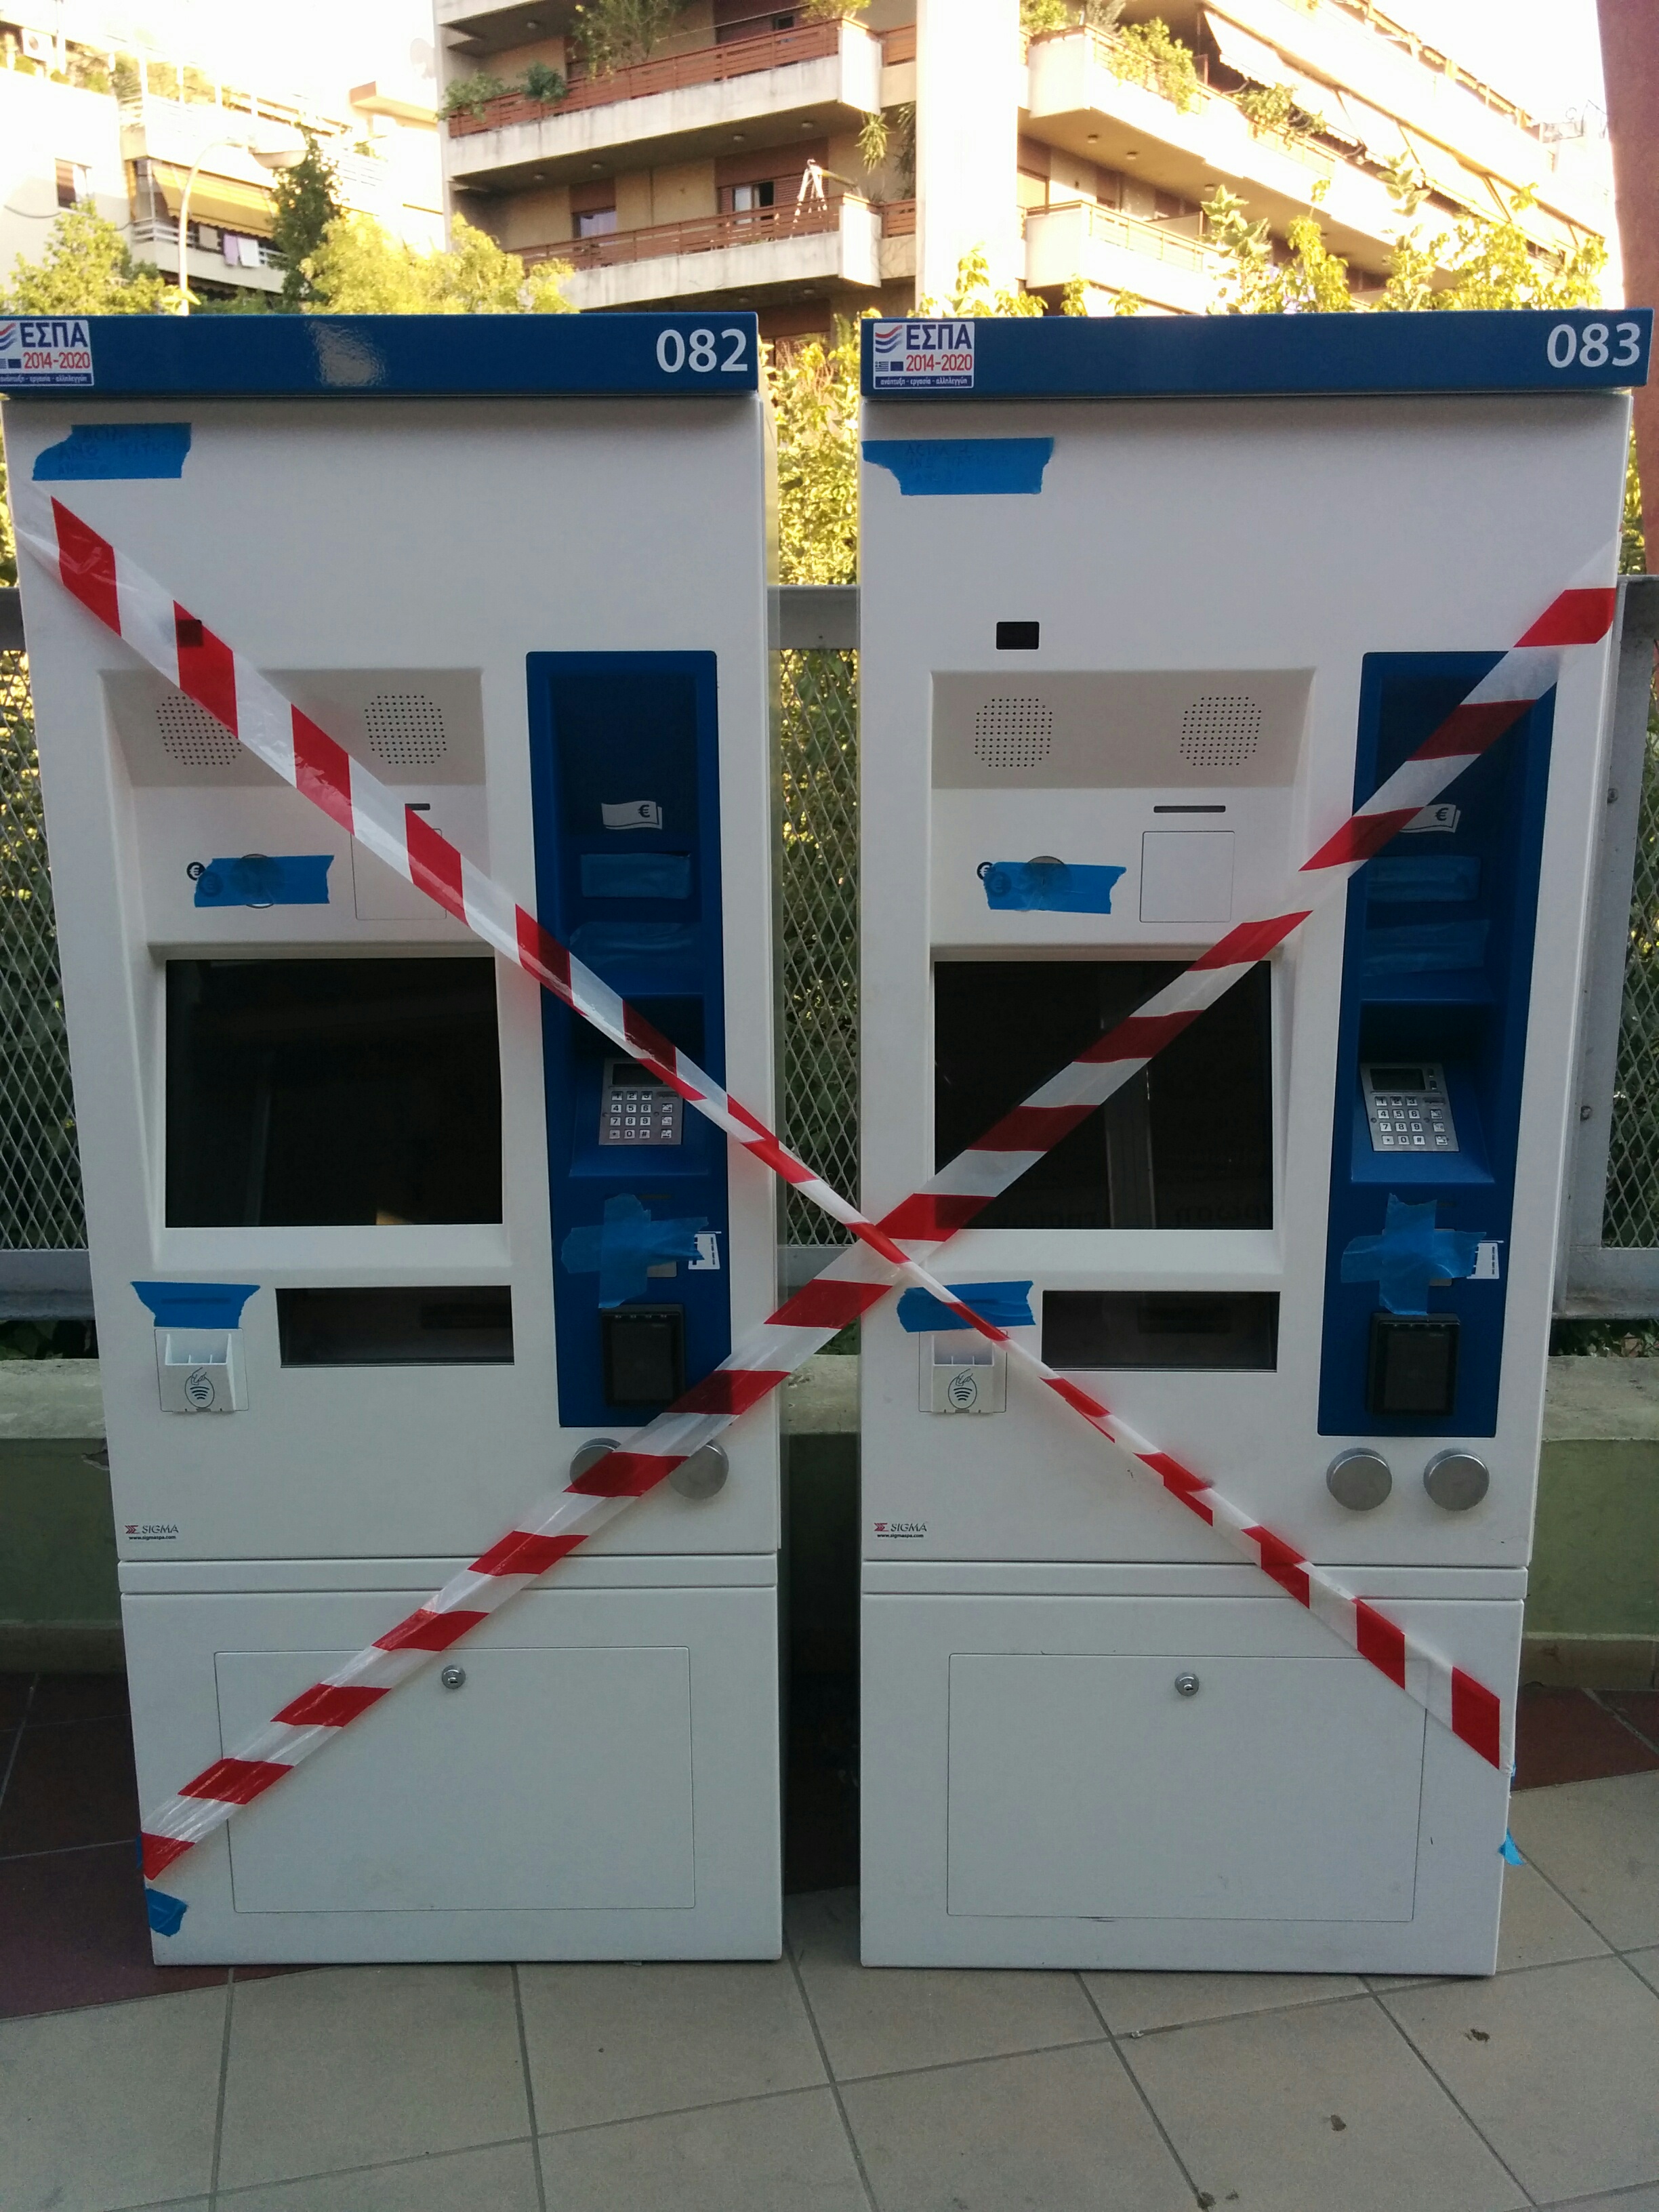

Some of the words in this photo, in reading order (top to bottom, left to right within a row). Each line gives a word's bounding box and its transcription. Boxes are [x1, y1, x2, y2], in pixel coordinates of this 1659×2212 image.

[20, 322, 88, 348] ΕΣΠΑ
[906, 324, 972, 350] ΕΣΠΑ
[1547, 323, 1641, 368] 083
[23, 352, 91, 369] 2014-2020
[656, 329, 748, 373] 082
[906, 354, 972, 371] 2014-2020
[142, 1524, 179, 1534] SIGMA
[890, 1523, 927, 1532] SIGMA
